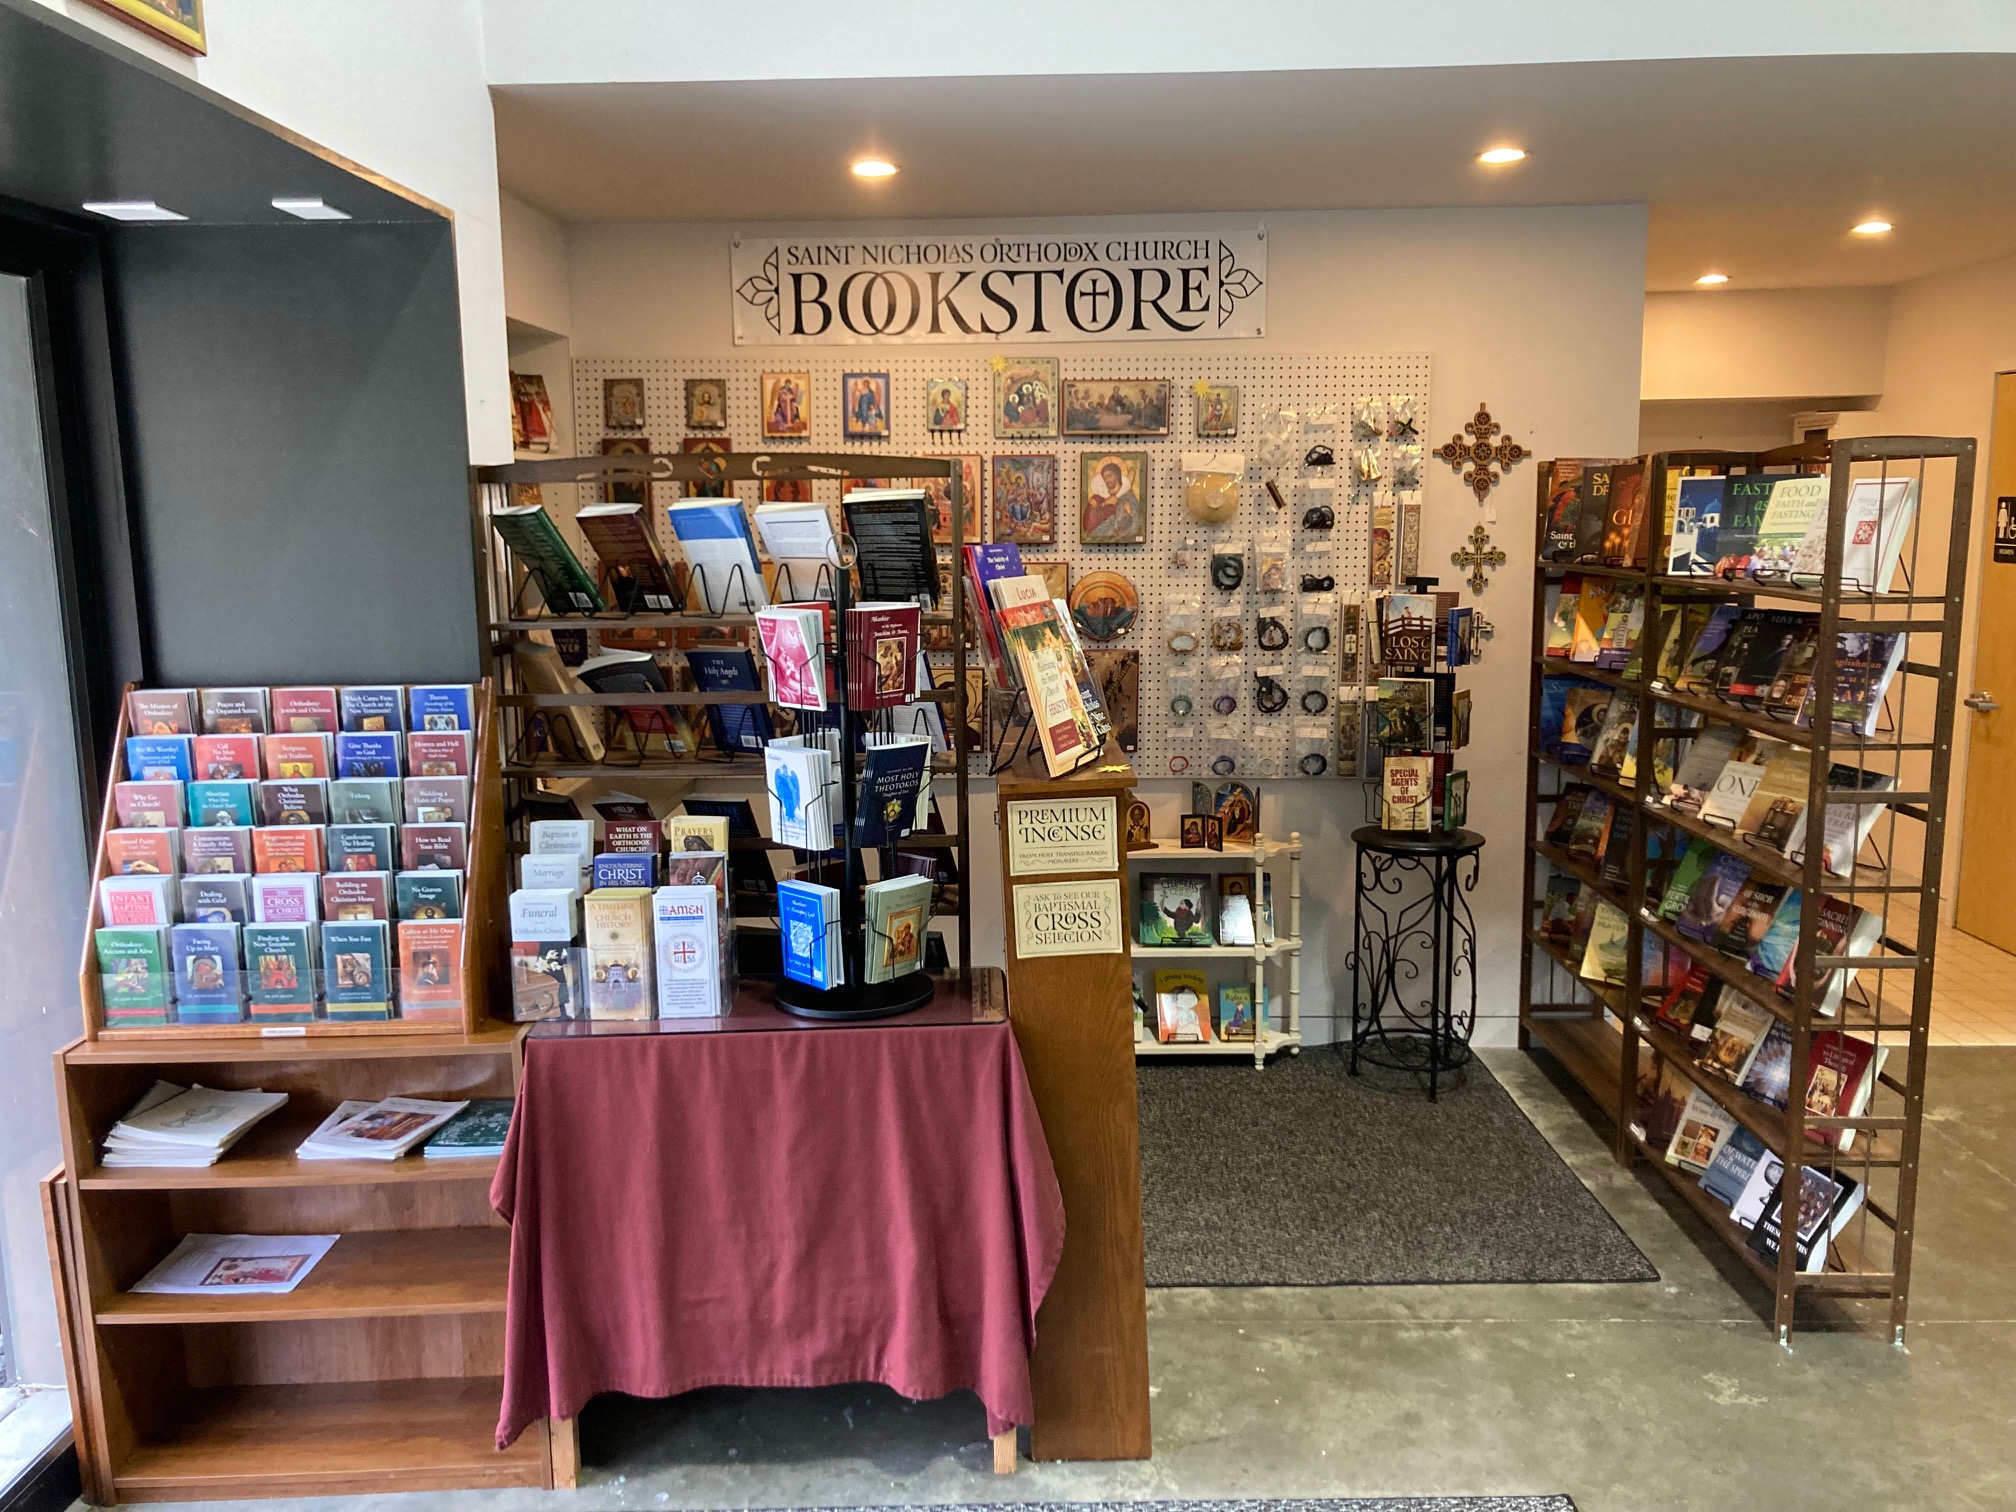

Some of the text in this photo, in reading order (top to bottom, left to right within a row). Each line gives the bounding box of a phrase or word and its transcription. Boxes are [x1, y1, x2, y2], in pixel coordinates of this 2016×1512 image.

[787, 240, 1211, 266] SAINT NICHOLAS ORTHODOX CHURCH
[789, 266, 1211, 336] BOOKSTORE
[1732, 483, 1775, 495] FAST
[1781, 485, 1821, 498] FOOD
[1775, 500, 1804, 508] FAITH
[1771, 509, 1814, 519] FASTING
[1550, 531, 1573, 540] Saint
[1016, 586, 1037, 600] LUCIA
[1392, 636, 1430, 648] LOST
[1385, 648, 1430, 660] SAINT
[704, 665, 738, 677] Holy Angels
[877, 772, 920, 784] MOST HOLY
[1390, 769, 1419, 777] SPECIAL
[875, 780, 919, 792] THEOTOKOS
[1391, 778, 1418, 786] AGENTS
[1401, 787, 1409, 795] OF
[1392, 795, 1418, 804] CHRIST
[1018, 807, 1107, 825] PREMIUM
[1827, 807, 1856, 820] LAURE
[674, 826, 714, 836] PRAYERS
[1019, 824, 1106, 843] INCENSE
[534, 870, 565, 878] Marriage
[599, 869, 645, 882] CHRIST
[268, 898, 299, 906] CROSS
[1034, 894, 1051, 902] ASK
[1064, 892, 1079, 900] SEE
[1081, 891, 1100, 899] OUR
[1753, 892, 1774, 904] SUCH
[522, 906, 557, 917] Funeral
[669, 905, 703, 915] AMEN
[1035, 912, 1102, 932] CROSS
[1822, 909, 1849, 924] SACRE
[1035, 930, 1102, 945] SELECTION
[1716, 1155, 1732, 1170] THE
[1723, 1145, 1757, 1170] OF WATE
[1763, 1221, 1780, 1238] THES
